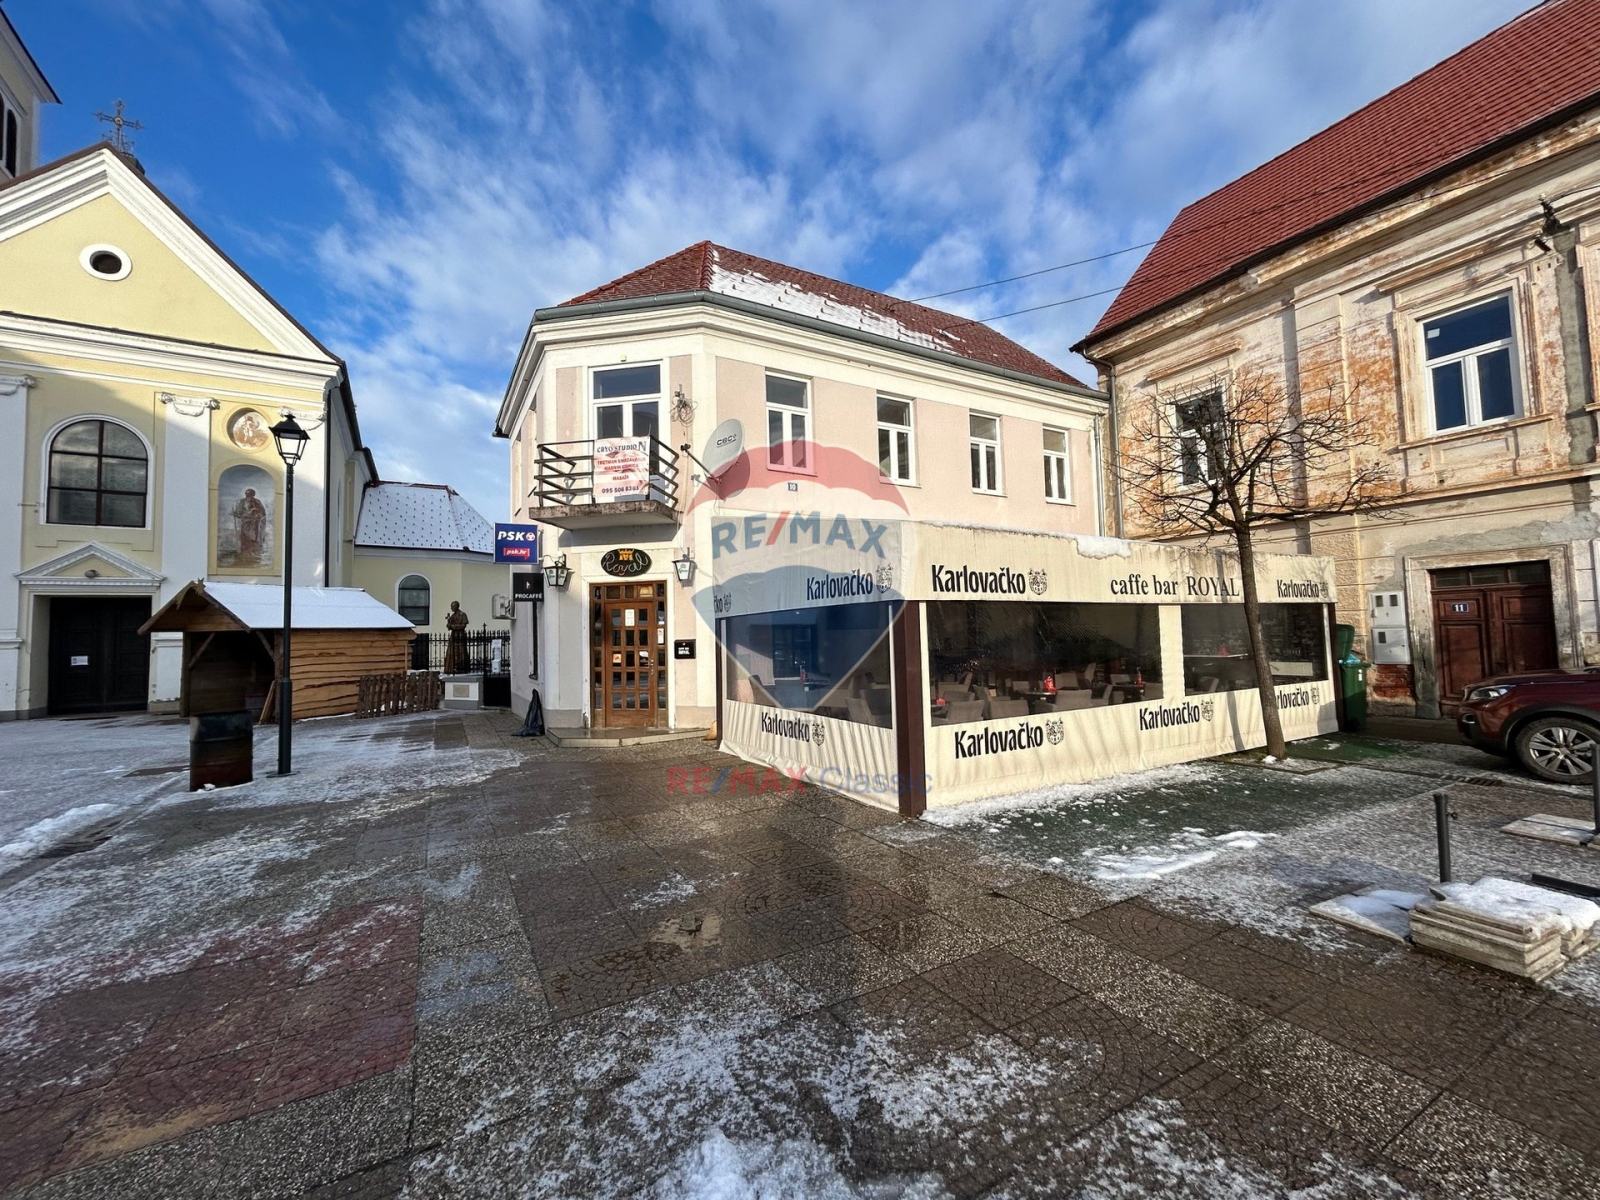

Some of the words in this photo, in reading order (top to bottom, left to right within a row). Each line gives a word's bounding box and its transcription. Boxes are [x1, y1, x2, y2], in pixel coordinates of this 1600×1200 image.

[638, 441, 647, 451] N
[497, 531, 525, 540] PSK
[602, 552, 649, 576] Royal
[806, 568, 874, 600] Karlovačko
[931, 564, 1026, 594] Karlovačko
[1110, 574, 1149, 595] caffe
[1152, 575, 1179, 595] bar
[1186, 576, 1240, 597] ROYAL
[1276, 579, 1320, 598] Karlovačko
[1455, 604, 1464, 612] 11
[1274, 687, 1309, 709] rlovačko
[761, 711, 810, 743] Karlovačko
[1139, 701, 1200, 731] Karlovačko
[954, 722, 1044, 759] Karlovačko
